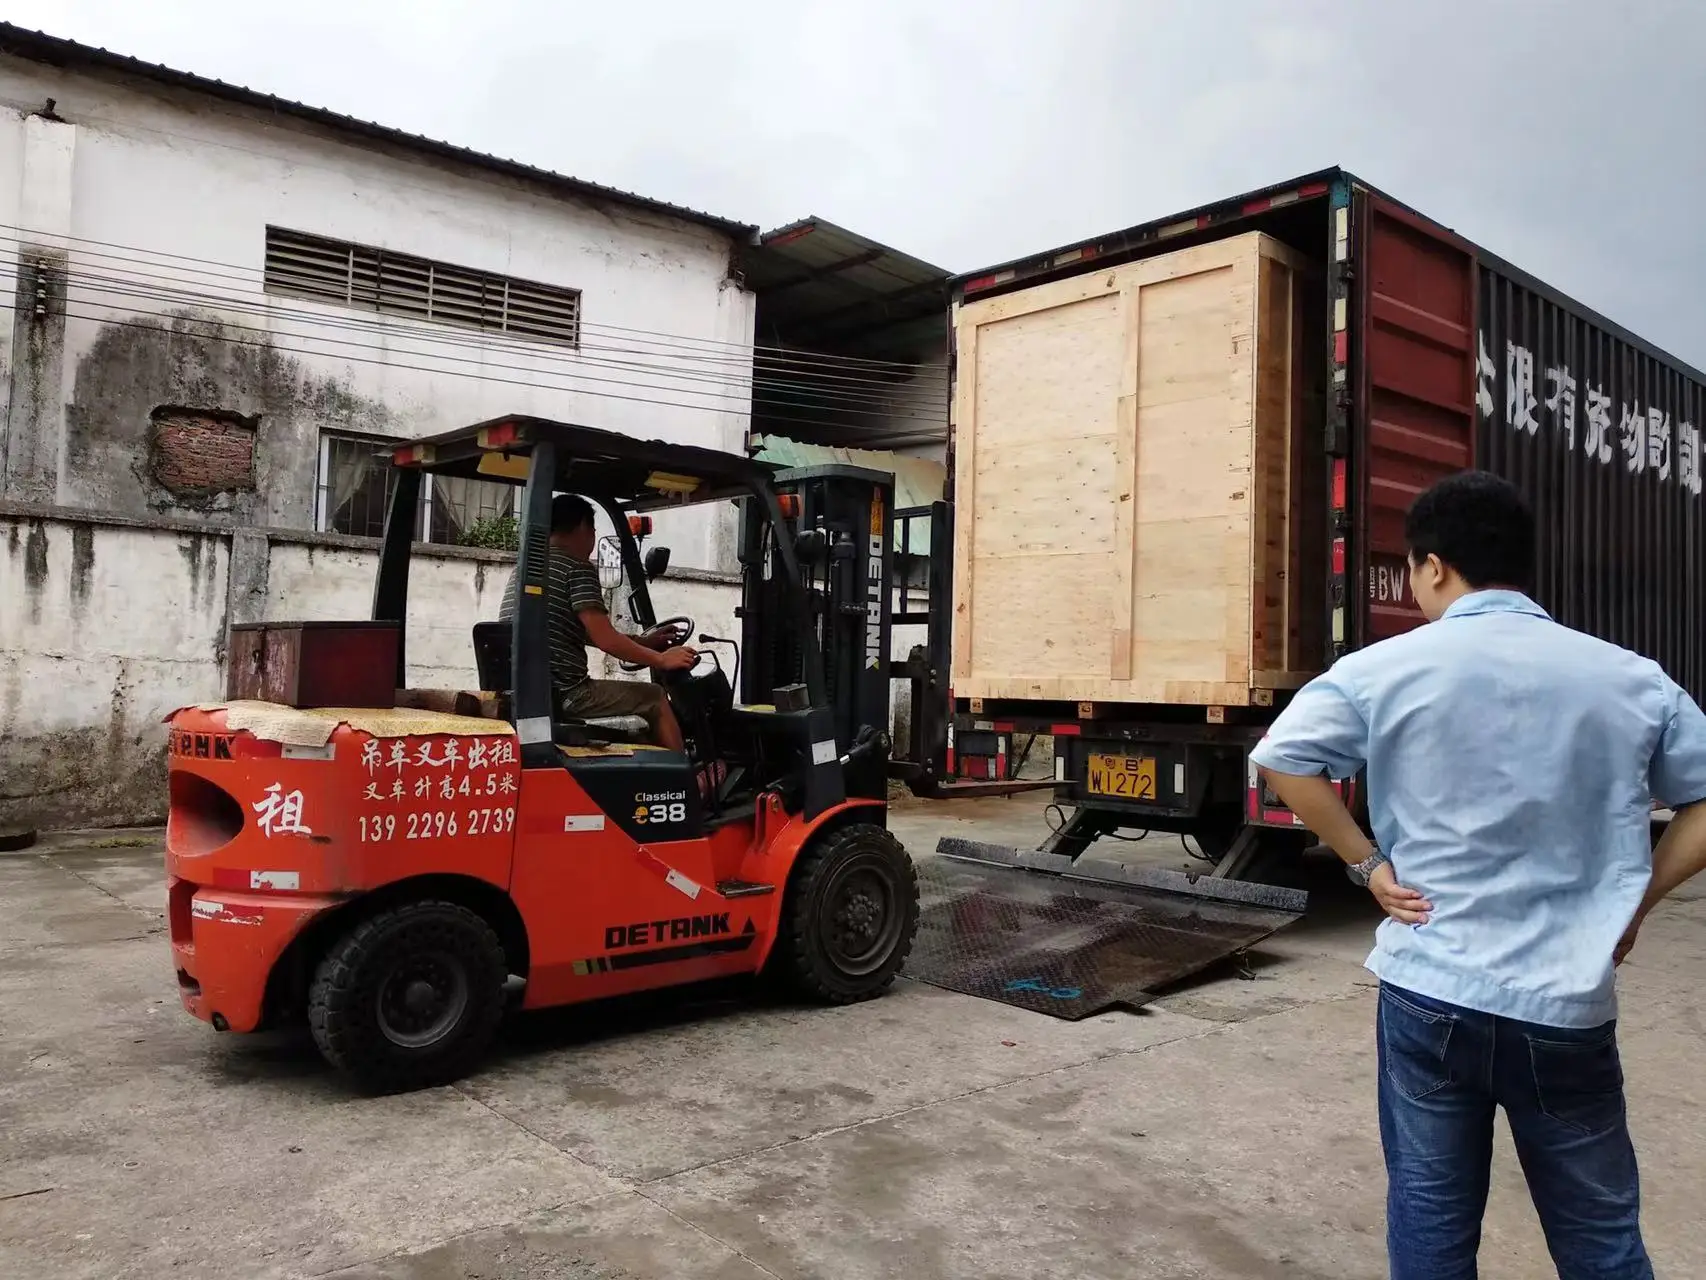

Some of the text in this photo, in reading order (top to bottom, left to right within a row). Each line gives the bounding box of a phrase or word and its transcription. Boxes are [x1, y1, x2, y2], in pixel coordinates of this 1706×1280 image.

[865, 535, 884, 671] DETANK
[635, 790, 686, 802] Classical
[1091, 770, 1153, 797] W1272
[252, 781, 313, 839] 租
[358, 807, 515, 842] 139 2296 2739
[605, 912, 730, 949] DETANK
